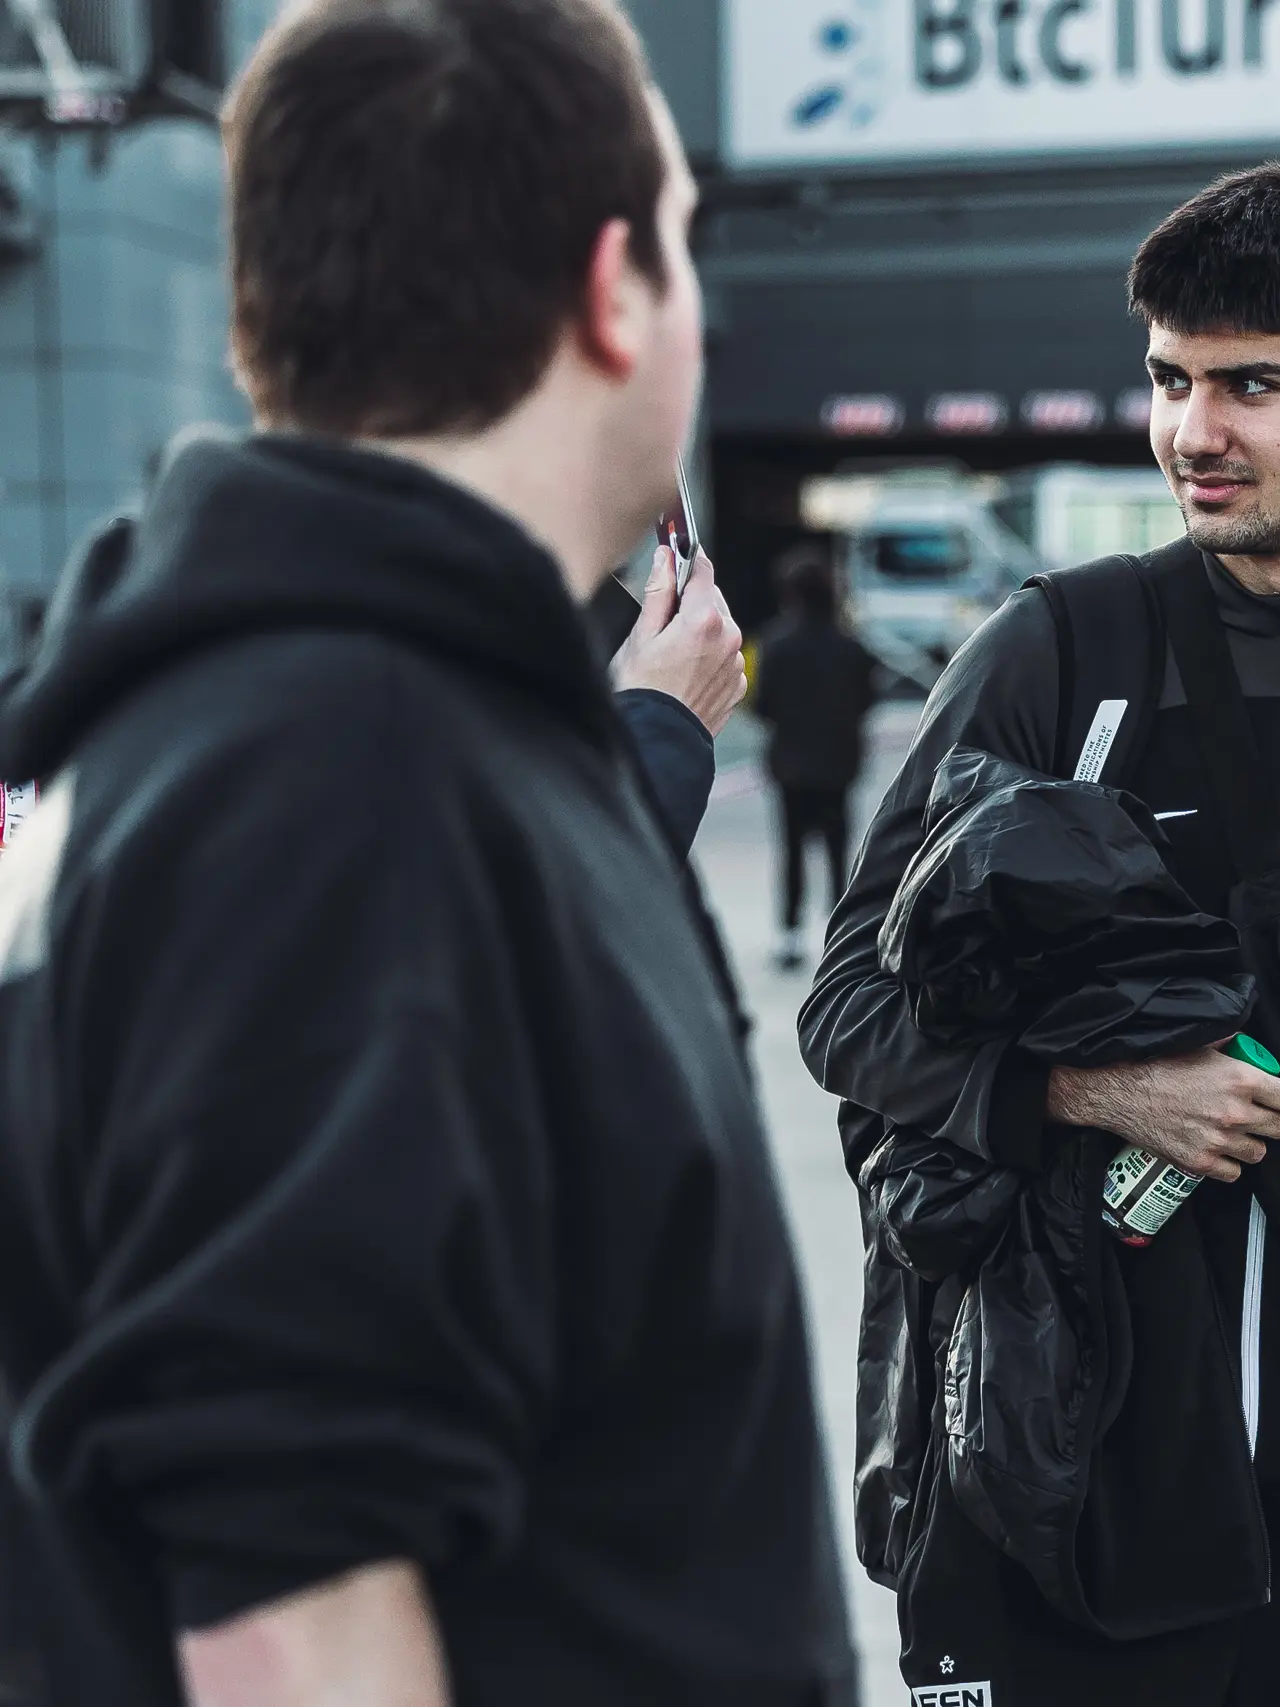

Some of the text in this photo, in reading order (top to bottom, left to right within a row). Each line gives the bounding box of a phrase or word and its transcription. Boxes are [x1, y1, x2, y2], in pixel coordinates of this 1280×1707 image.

[1101, 724, 1107, 733] OF
[1087, 740, 1095, 752] THE
[1090, 729, 1112, 782] ONSHIP ATHLETES
[918, 1688, 984, 1707] FCN
